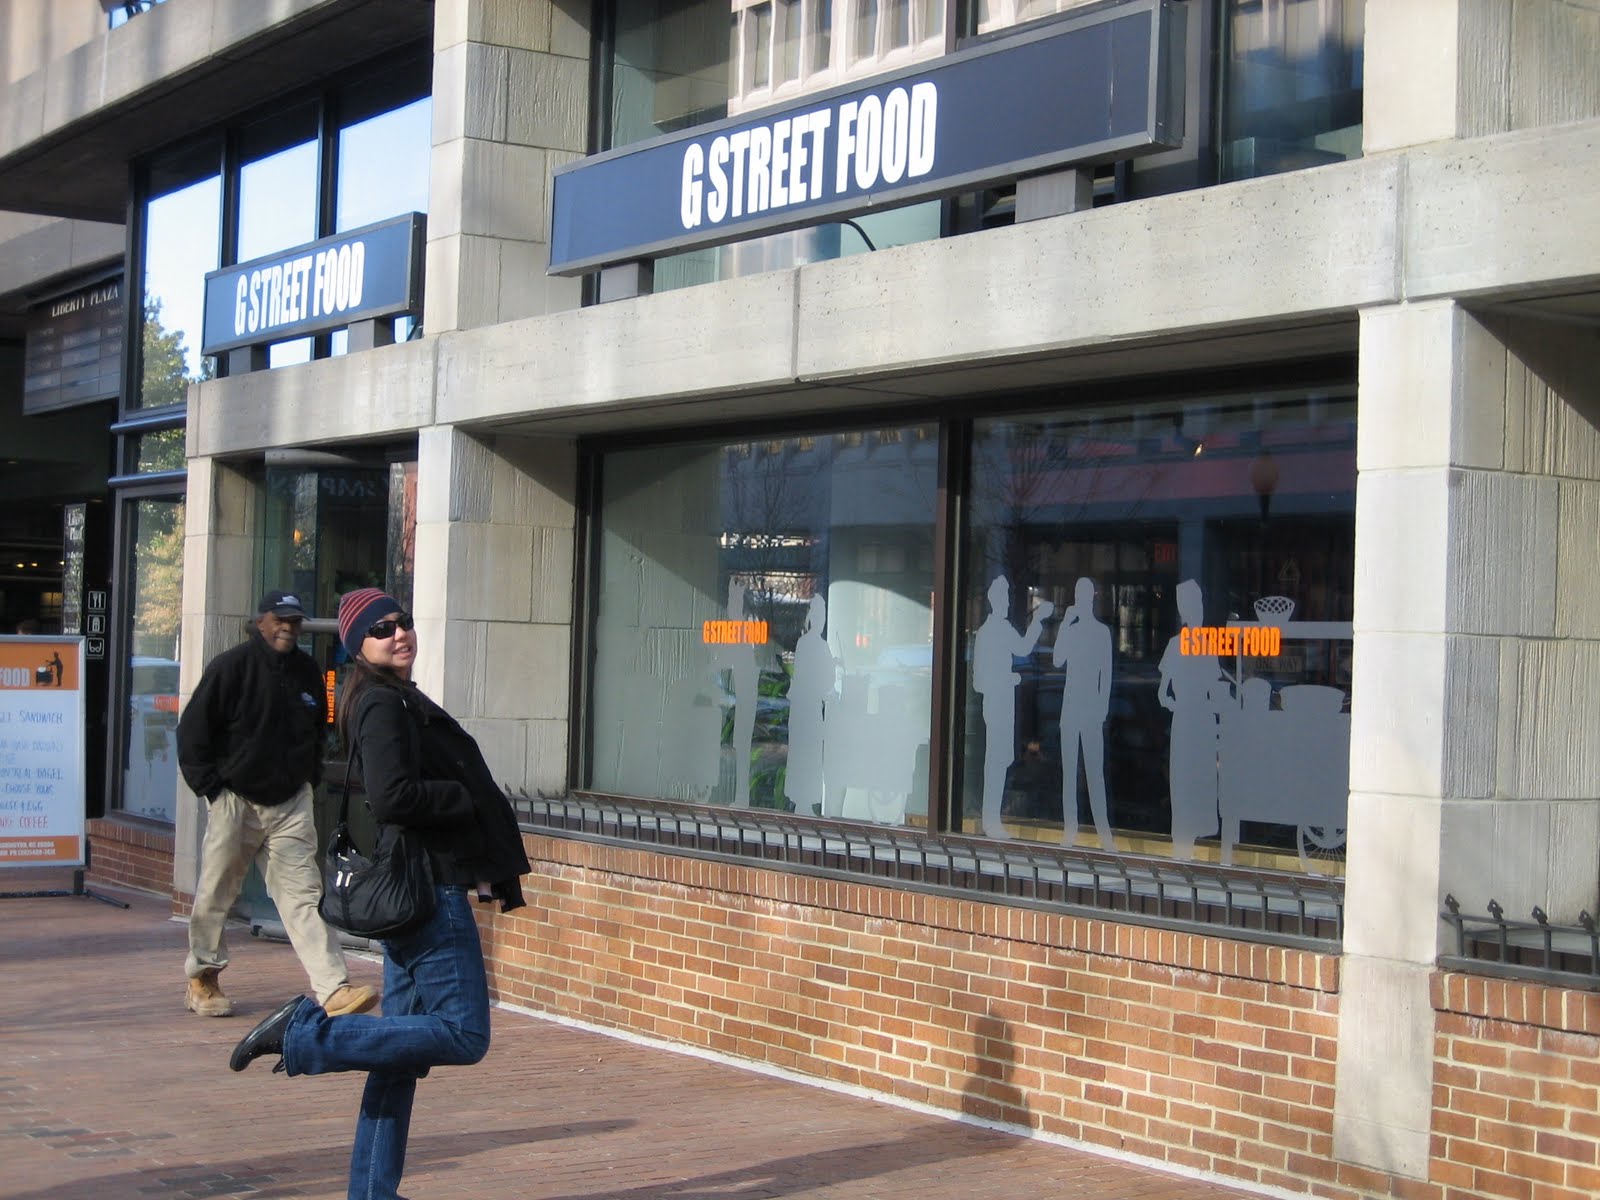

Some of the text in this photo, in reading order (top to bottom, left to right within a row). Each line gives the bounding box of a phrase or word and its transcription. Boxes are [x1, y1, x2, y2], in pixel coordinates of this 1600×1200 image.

[680, 81, 938, 229] G STREET FOOD
[52, 297, 85, 317] LIBERTY
[90, 284, 119, 306] PLAZA
[234, 241, 365, 337] G STREET FOOD
[703, 621, 768, 644] G STREET FOOD
[1180, 626, 1281, 657] G STREET FOOD
[327, 670, 336, 690] FOOD
[19, 709, 64, 724] SANDWICH
[19, 815, 48, 829] COFFEE
